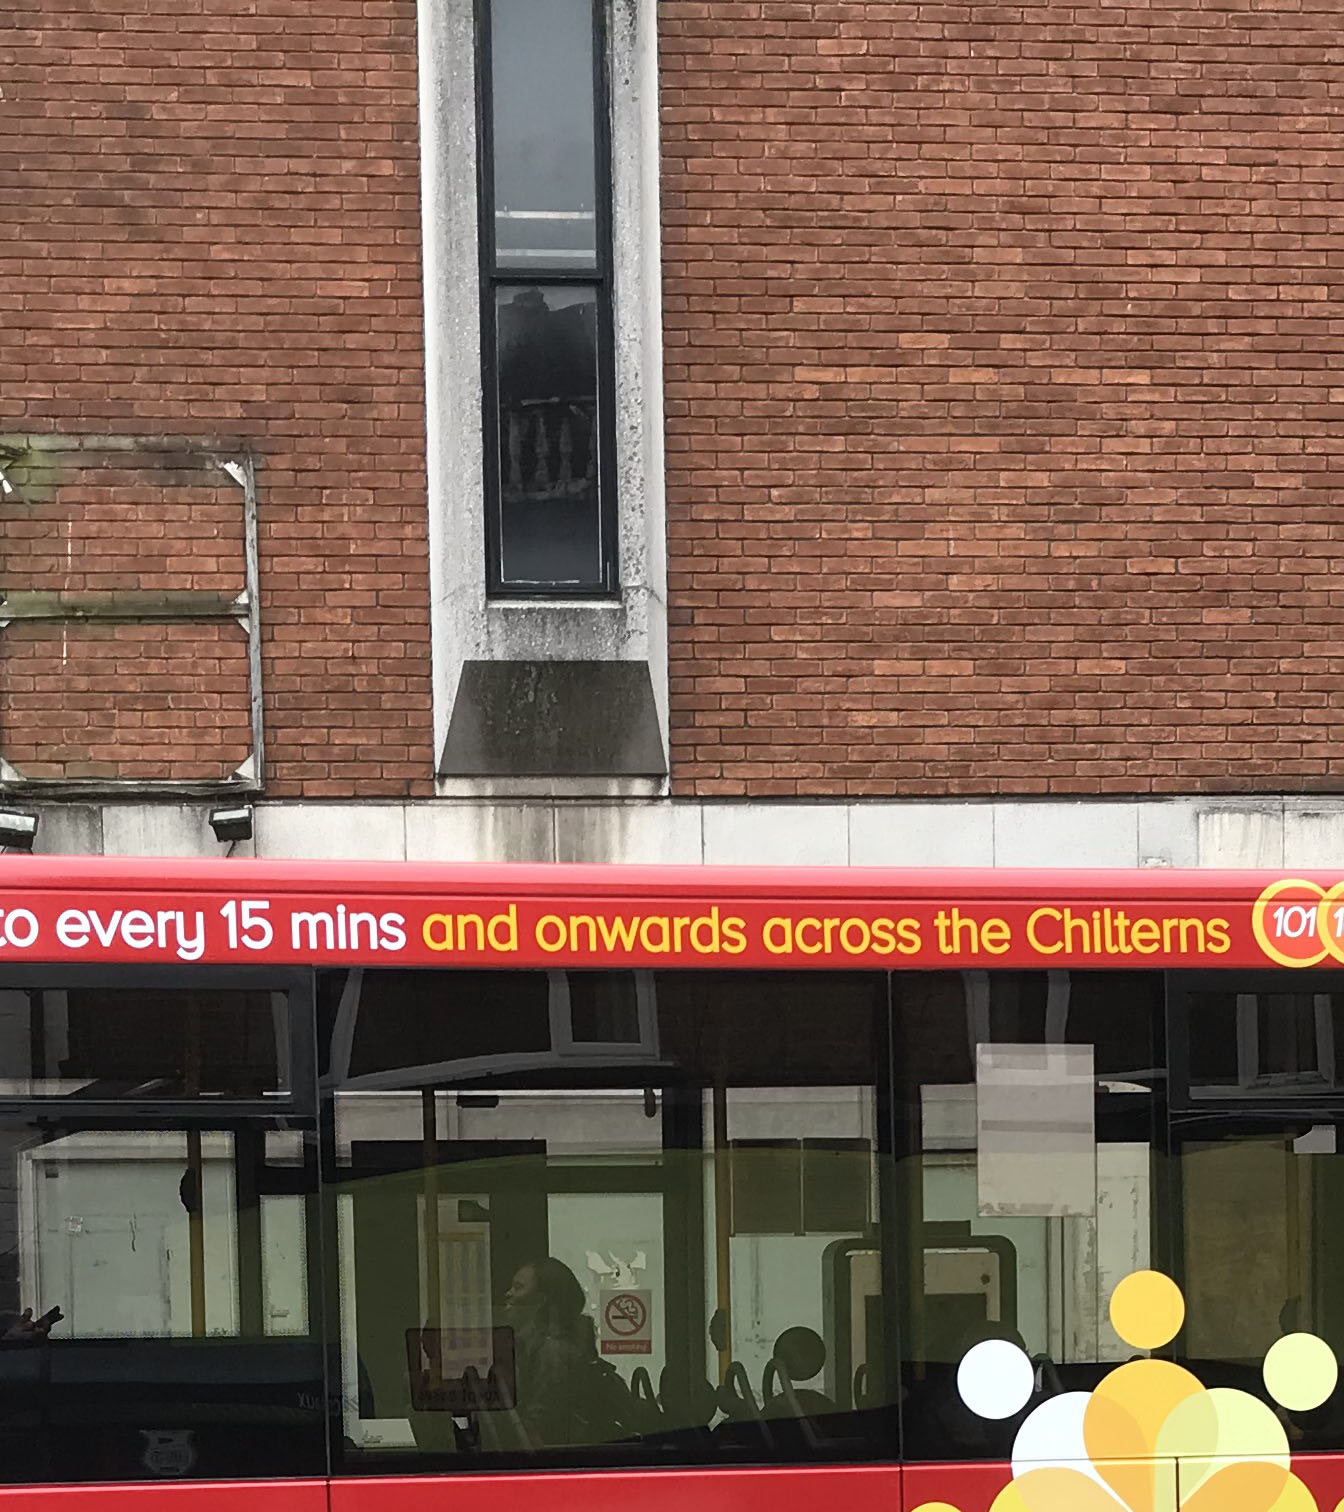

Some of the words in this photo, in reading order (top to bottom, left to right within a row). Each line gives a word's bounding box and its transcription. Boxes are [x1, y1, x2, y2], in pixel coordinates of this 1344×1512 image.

[56, 909, 205, 960] every
[220, 900, 273, 949] 15
[291, 904, 407, 952] mins
[422, 904, 518, 952] and
[535, 906, 746, 953] onwards
[762, 915, 921, 954] across
[933, 907, 1011, 953] the
[1026, 907, 1231, 954] Chilterns
[1272, 908, 1316, 938] 101
